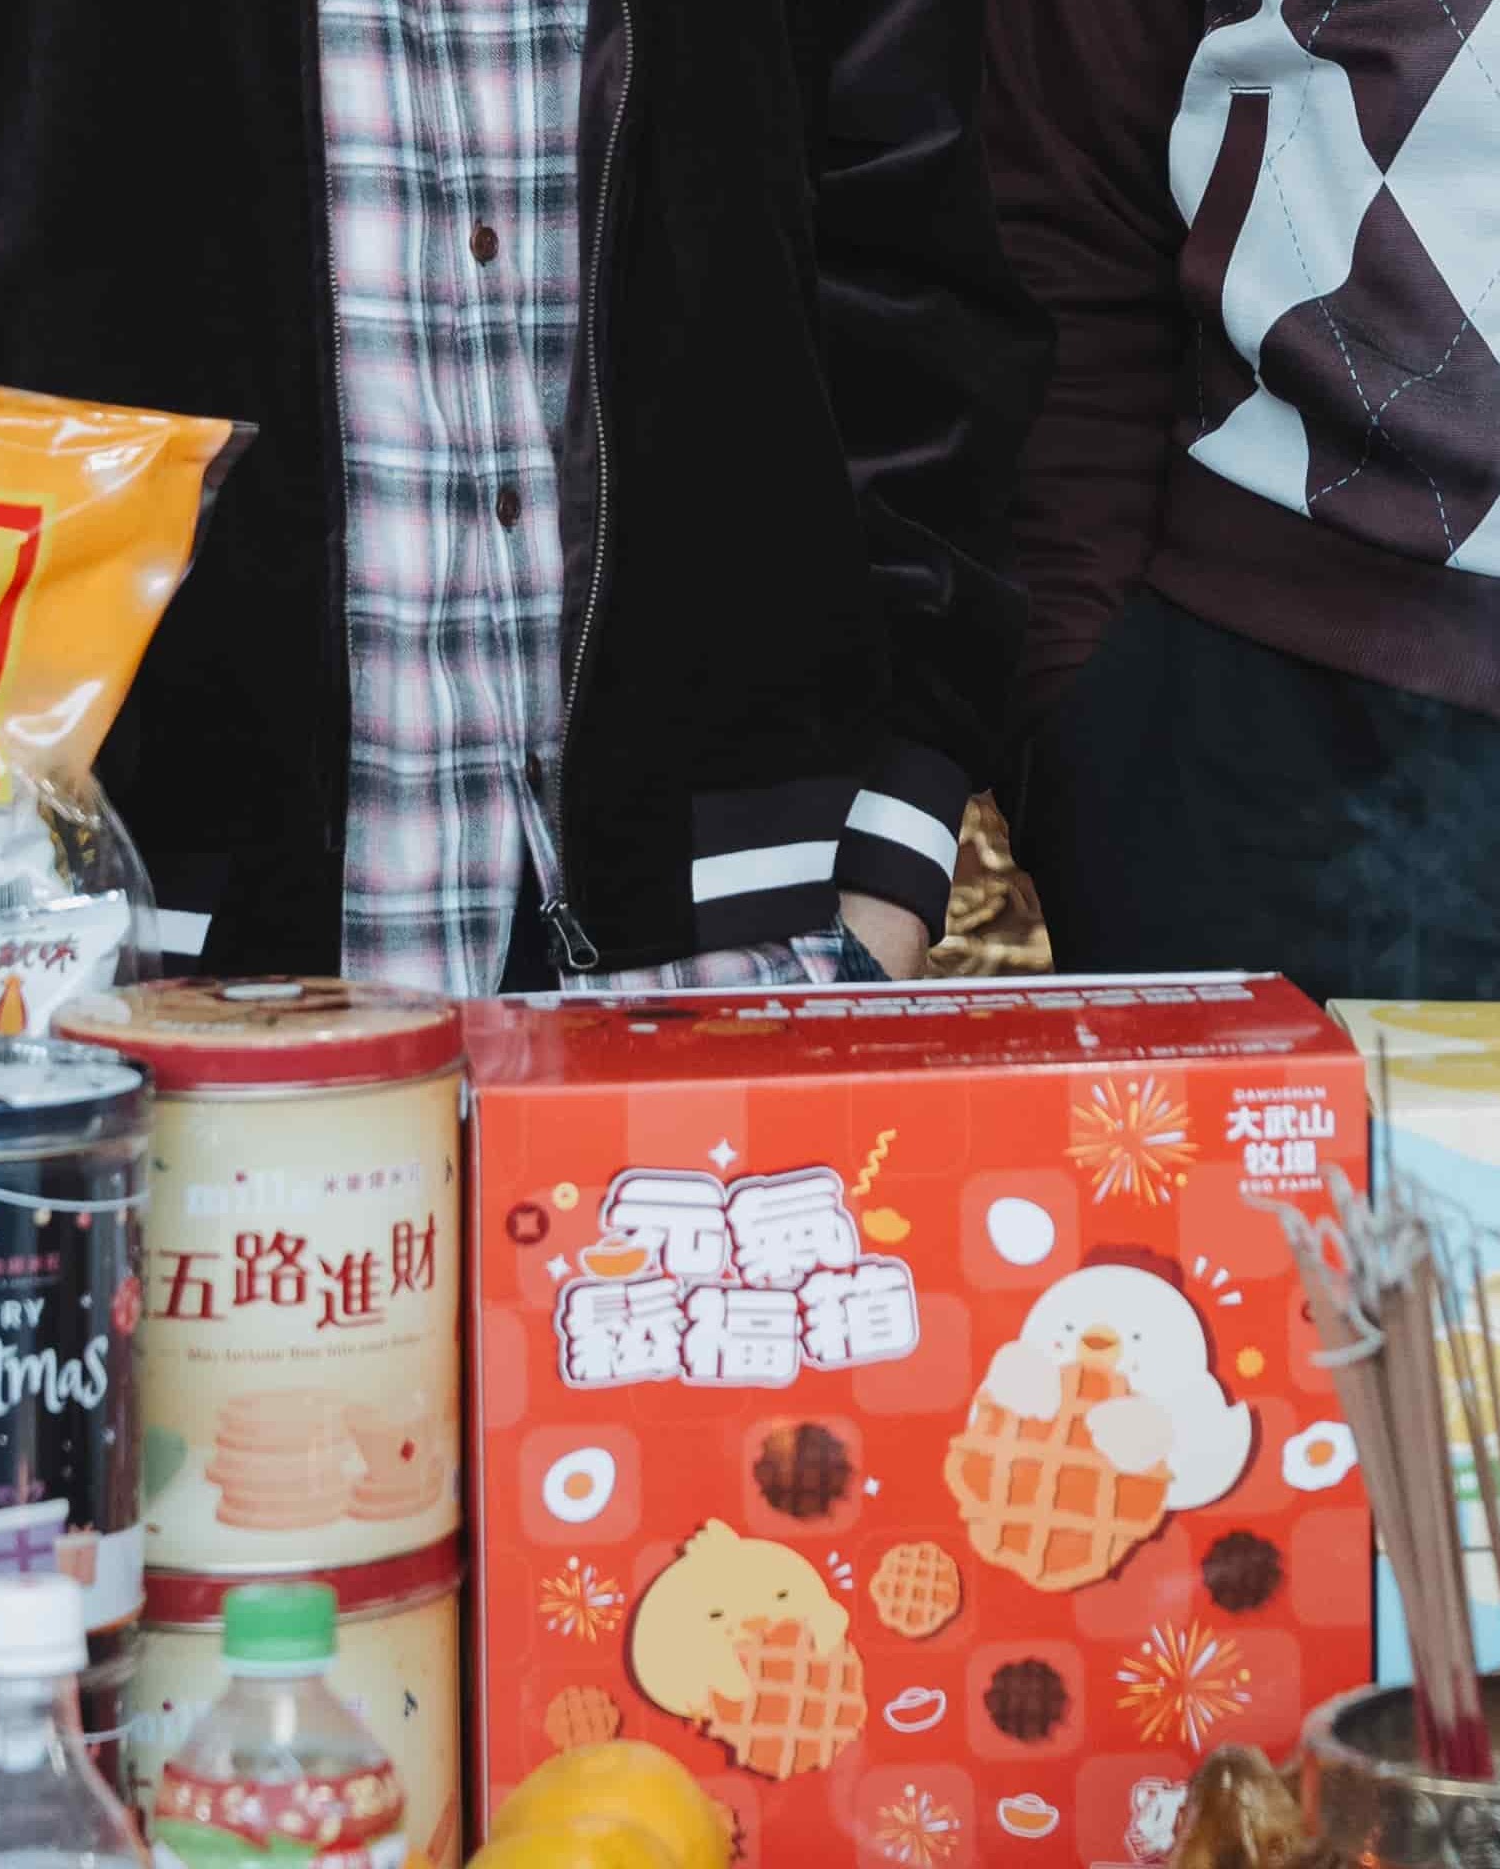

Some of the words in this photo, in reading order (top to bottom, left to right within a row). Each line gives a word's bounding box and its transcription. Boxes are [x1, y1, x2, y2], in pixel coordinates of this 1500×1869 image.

[1225, 1102, 1336, 1143] 大武山
[1244, 1140, 1318, 1176] 牧場
[150, 1211, 440, 1331] 五路進財
[604, 1174, 858, 1288] 元氣
[563, 1259, 915, 1383] 鬆福箱
